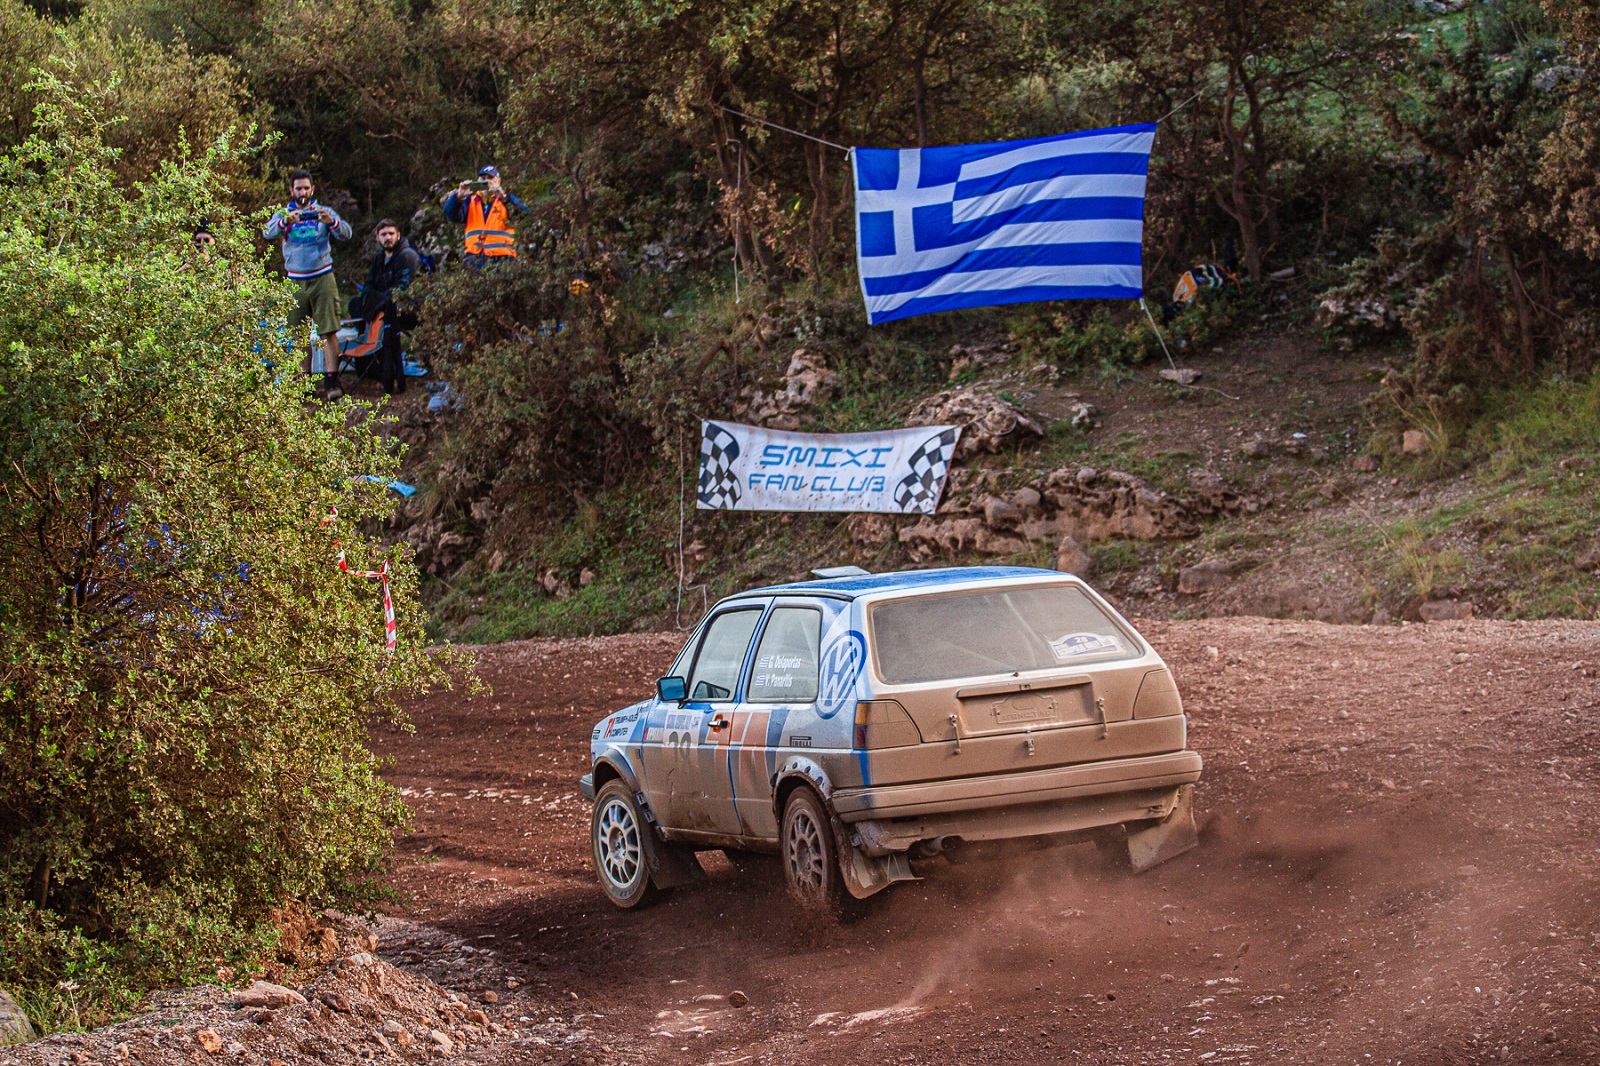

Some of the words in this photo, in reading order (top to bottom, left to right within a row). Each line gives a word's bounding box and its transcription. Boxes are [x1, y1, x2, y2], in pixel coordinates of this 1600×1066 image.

[759, 444, 894, 469] SMIXI
[749, 473, 805, 492] FAN
[810, 475, 887, 493] CLUB
[1074, 636, 1089, 644] 28
[789, 735, 812, 748] PIRELLI
